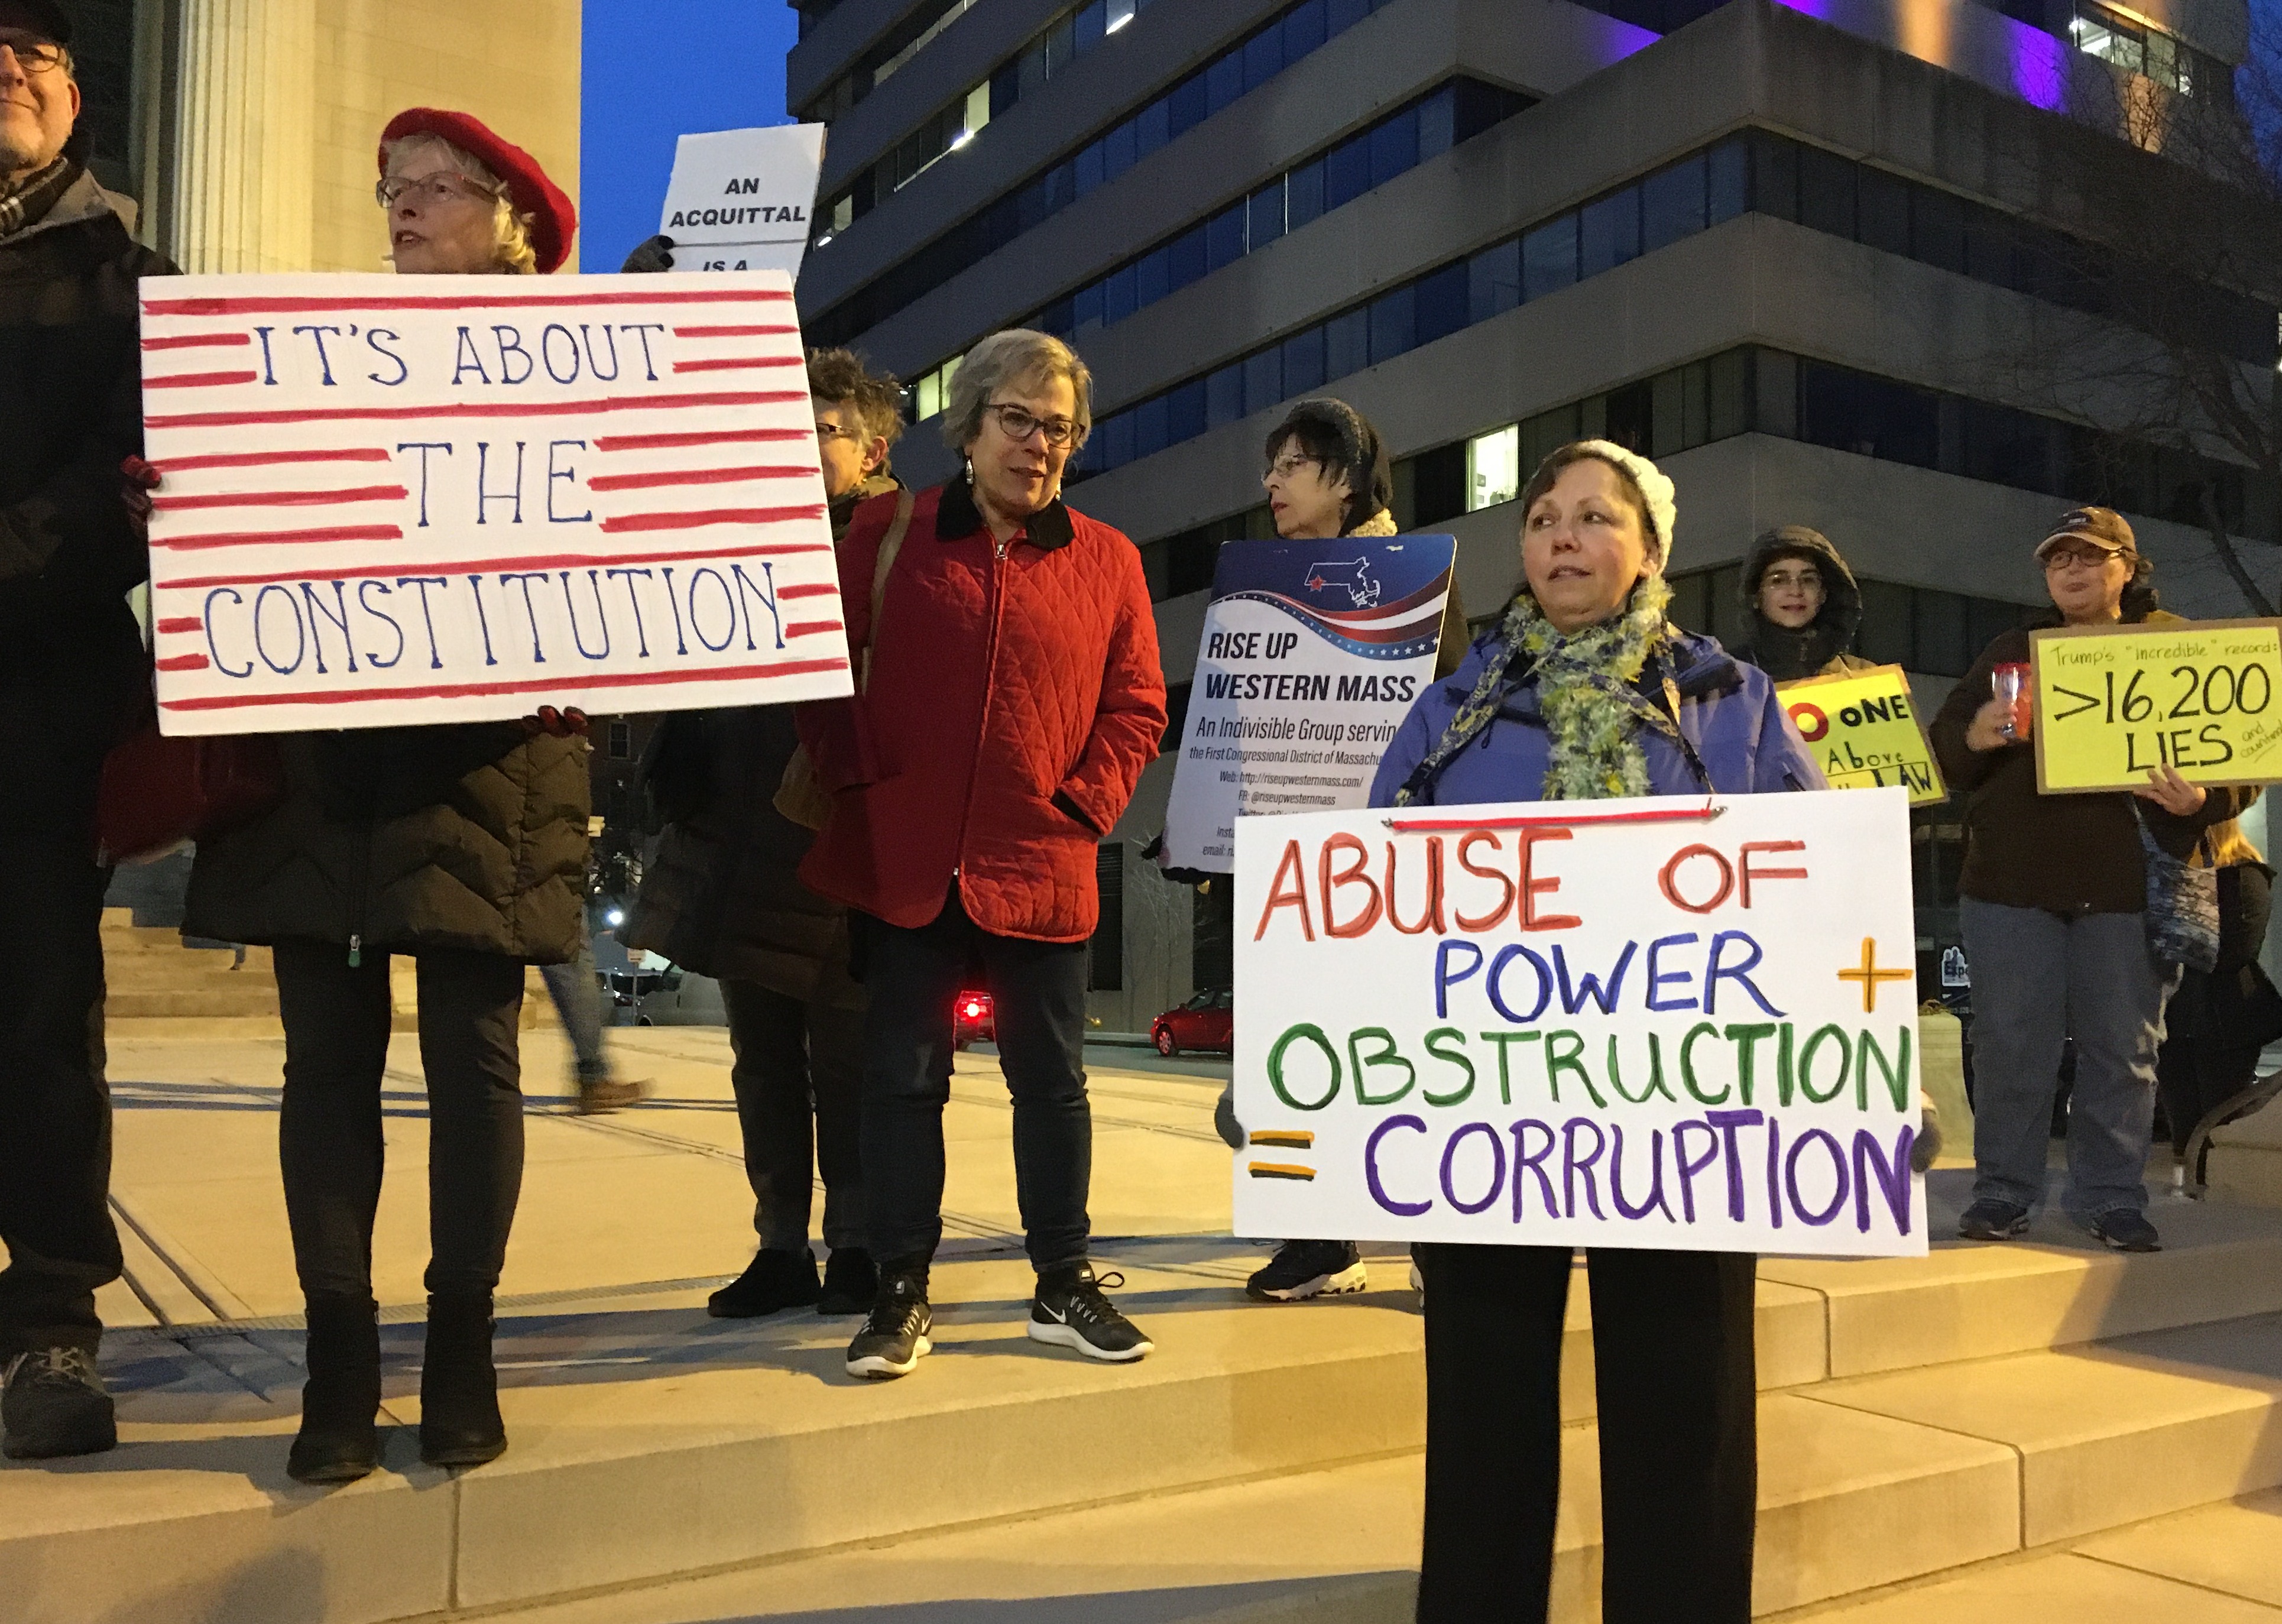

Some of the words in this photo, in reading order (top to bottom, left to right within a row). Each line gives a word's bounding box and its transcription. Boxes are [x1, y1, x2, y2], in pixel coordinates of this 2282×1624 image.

[724, 177, 759, 194] AN
[669, 206, 806, 227] ACQUITTAL
[254, 324, 409, 386] IT'S
[452, 324, 664, 385] ABOUT
[397, 440, 592, 527] THE
[204, 562, 786, 678] CONSTITUTION
[1207, 632, 1261, 659] RISE
[1265, 632, 1298, 659] UP
[2050, 642, 2115, 666] Trump's
[2225, 641, 2277, 656] record:
[1206, 673, 1330, 701] WESTERN
[1336, 675, 1416, 702] MASS
[1196, 716, 1215, 737] An
[1219, 717, 1295, 740] Indivisible
[1298, 718, 1344, 746] Group
[1787, 702, 1829, 743] O
[1189, 746, 1204, 759] the
[1205, 746, 1225, 760] First
[1226, 747, 1289, 764] Congressional
[1289, 750, 1323, 764] District
[1324, 750, 1336, 764] of
[1827, 741, 1904, 773] Above
[2125, 723, 2234, 773] LIES
[1220, 770, 1238, 783] Web:
[1238, 790, 1249, 802] FB:
[1254, 828, 1583, 942] ABUSE
[1658, 840, 1808, 914] OF
[1435, 929, 1788, 1023] POWER
[1268, 1023, 1911, 1112] OBSTRUCTION
[1364, 1110, 1918, 1236] CORRUPTION
